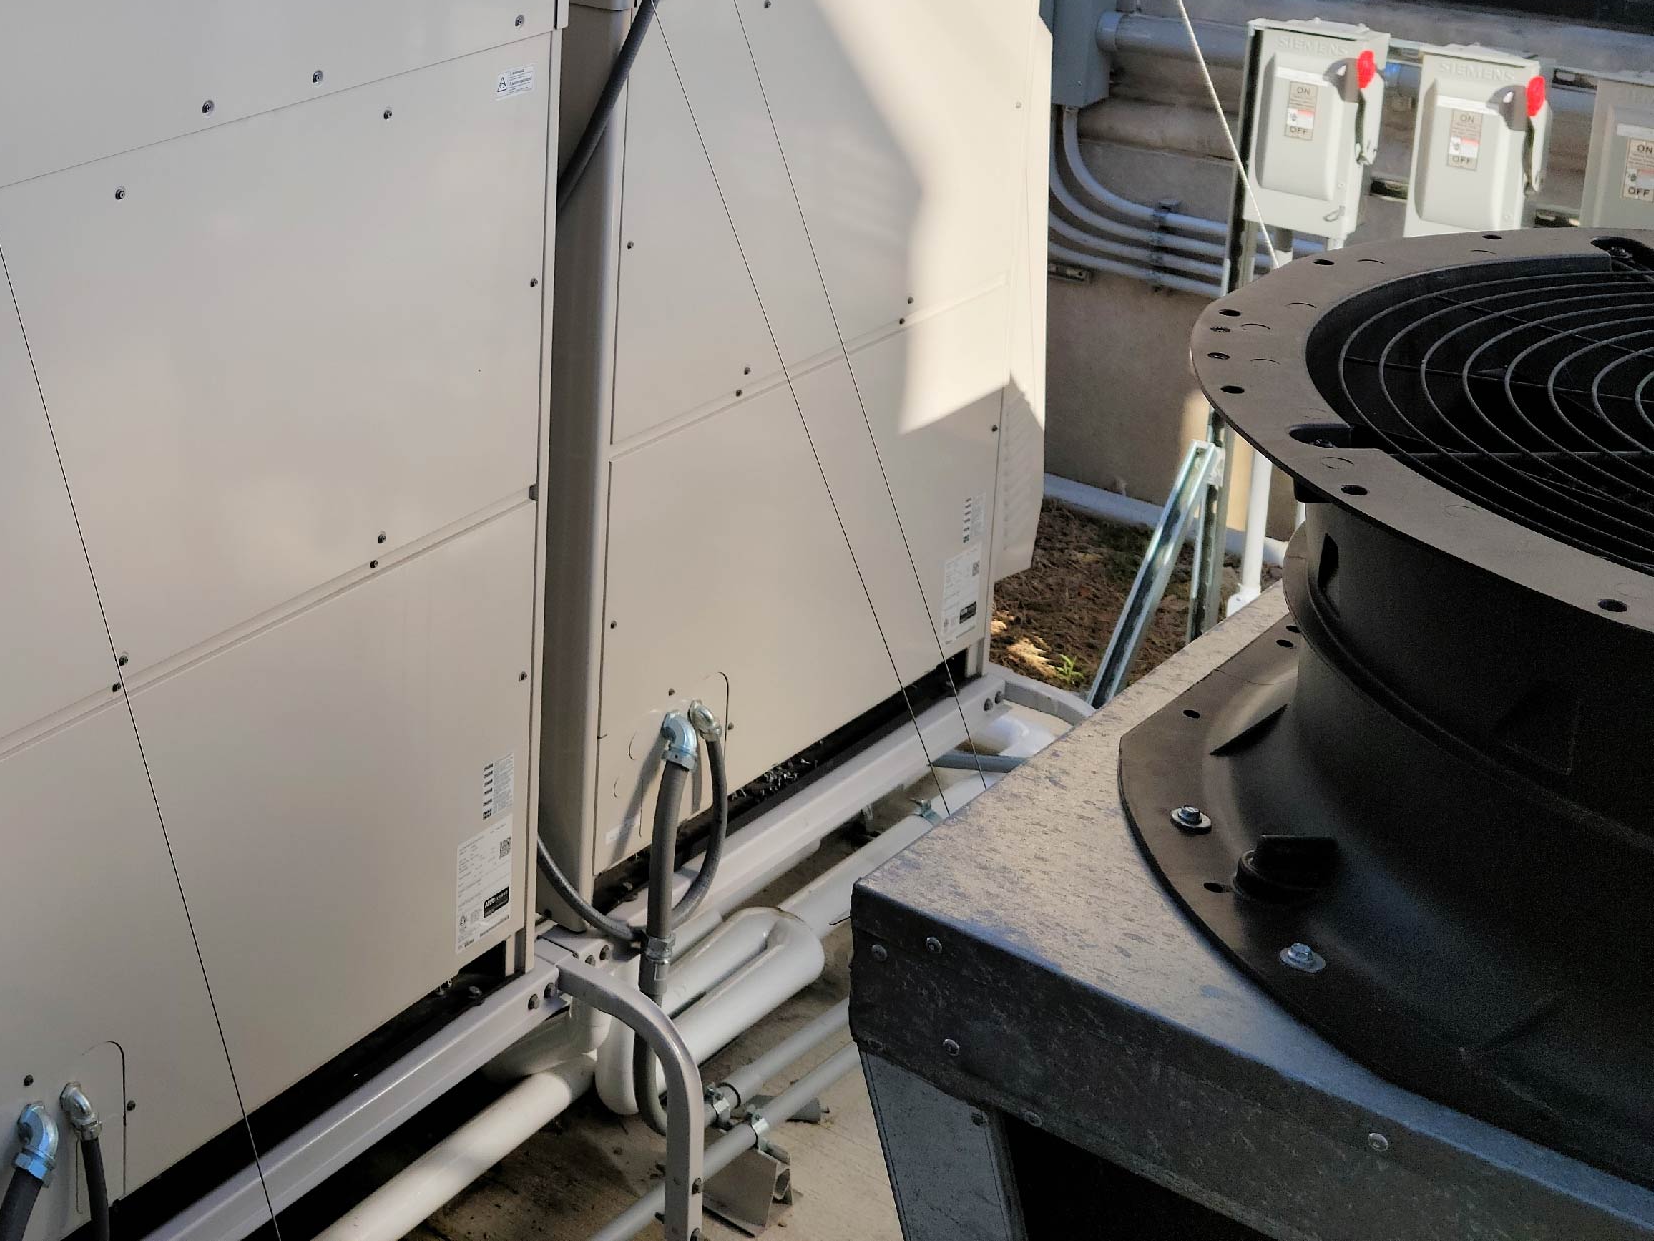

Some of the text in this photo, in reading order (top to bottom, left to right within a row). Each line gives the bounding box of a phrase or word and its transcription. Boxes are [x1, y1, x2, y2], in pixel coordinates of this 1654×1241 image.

[1276, 36, 1348, 57] SIEMENS
[1440, 62, 1515, 81] SIEMENS
[1297, 86, 1311, 96] ON
[1460, 113, 1475, 123] ON
[1289, 125, 1309, 135] OFF
[1637, 144, 1653, 154] ON
[1452, 155, 1470, 165] OFF
[1628, 186, 1650, 196] OFF
